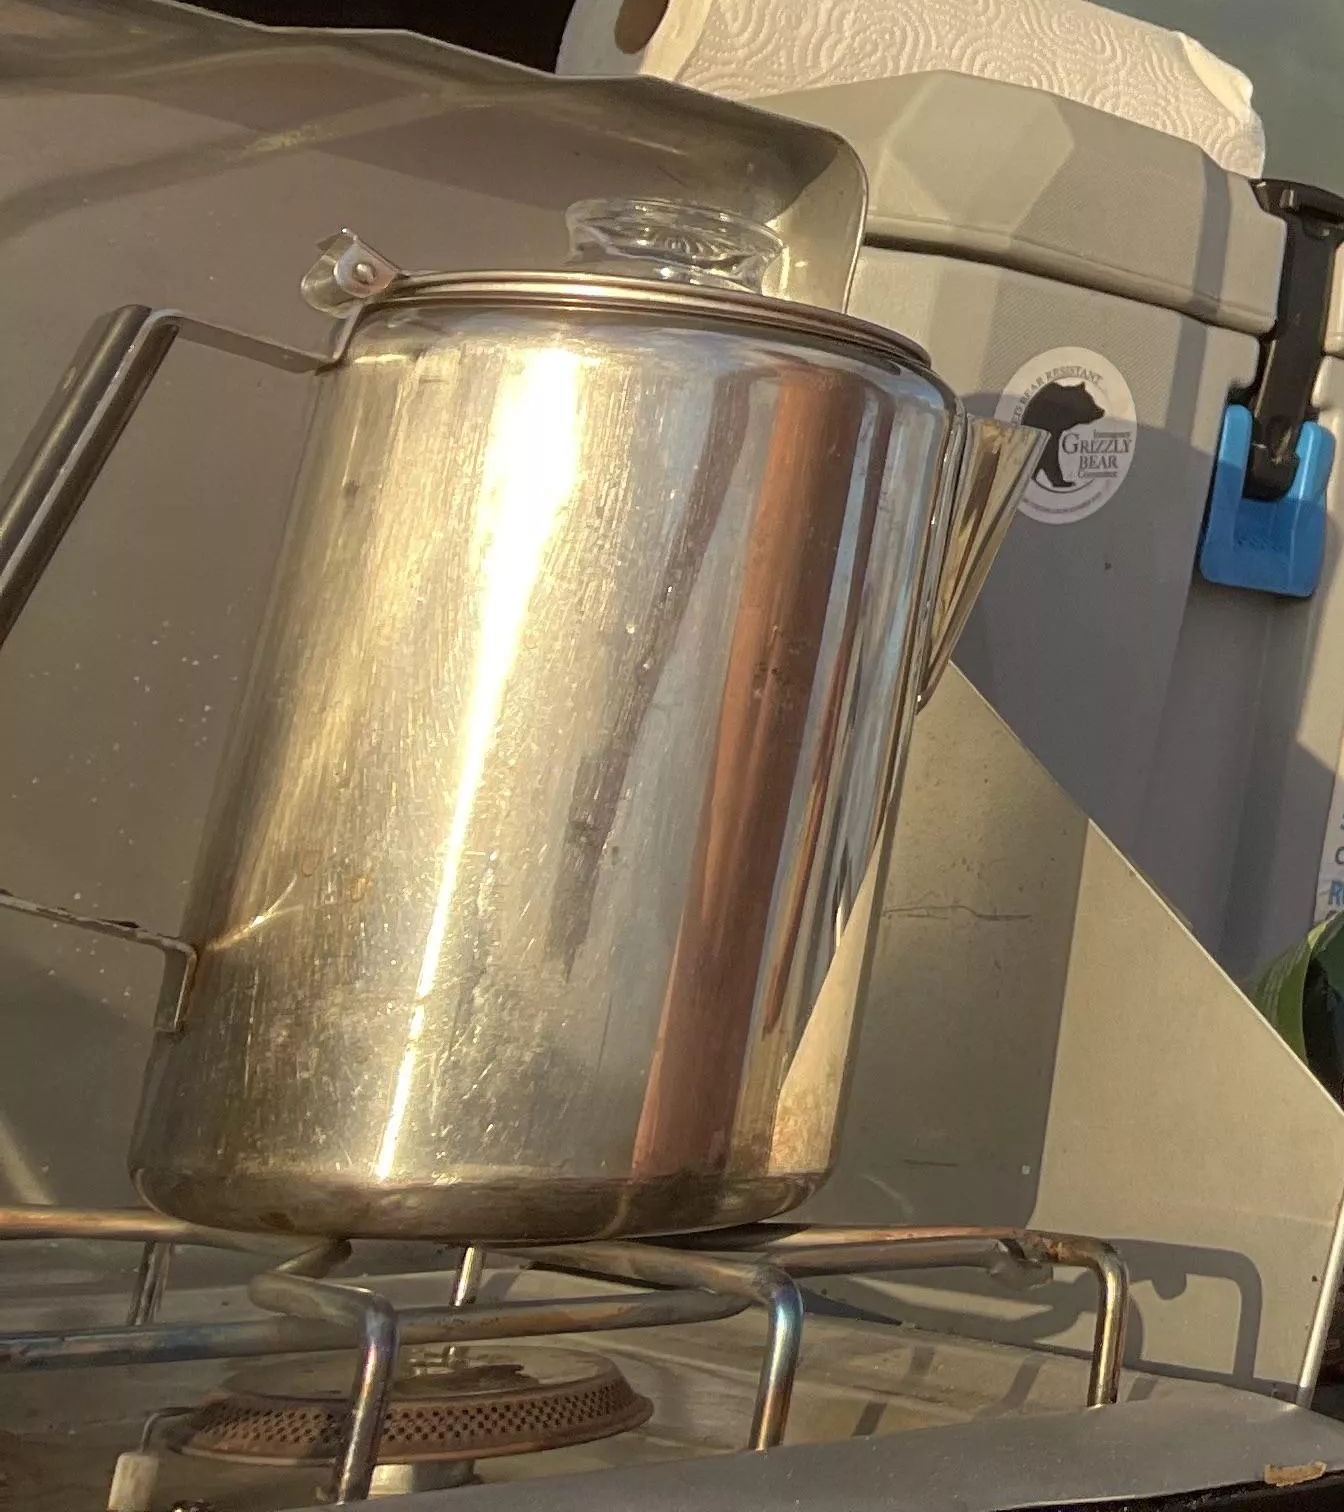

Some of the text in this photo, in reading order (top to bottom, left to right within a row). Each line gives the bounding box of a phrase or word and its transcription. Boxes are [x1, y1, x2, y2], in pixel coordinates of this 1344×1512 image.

[1044, 365, 1104, 385] RESISTANT
[1061, 432, 1132, 455] GRIZZLY
[1080, 455, 1118, 470] BEAR
